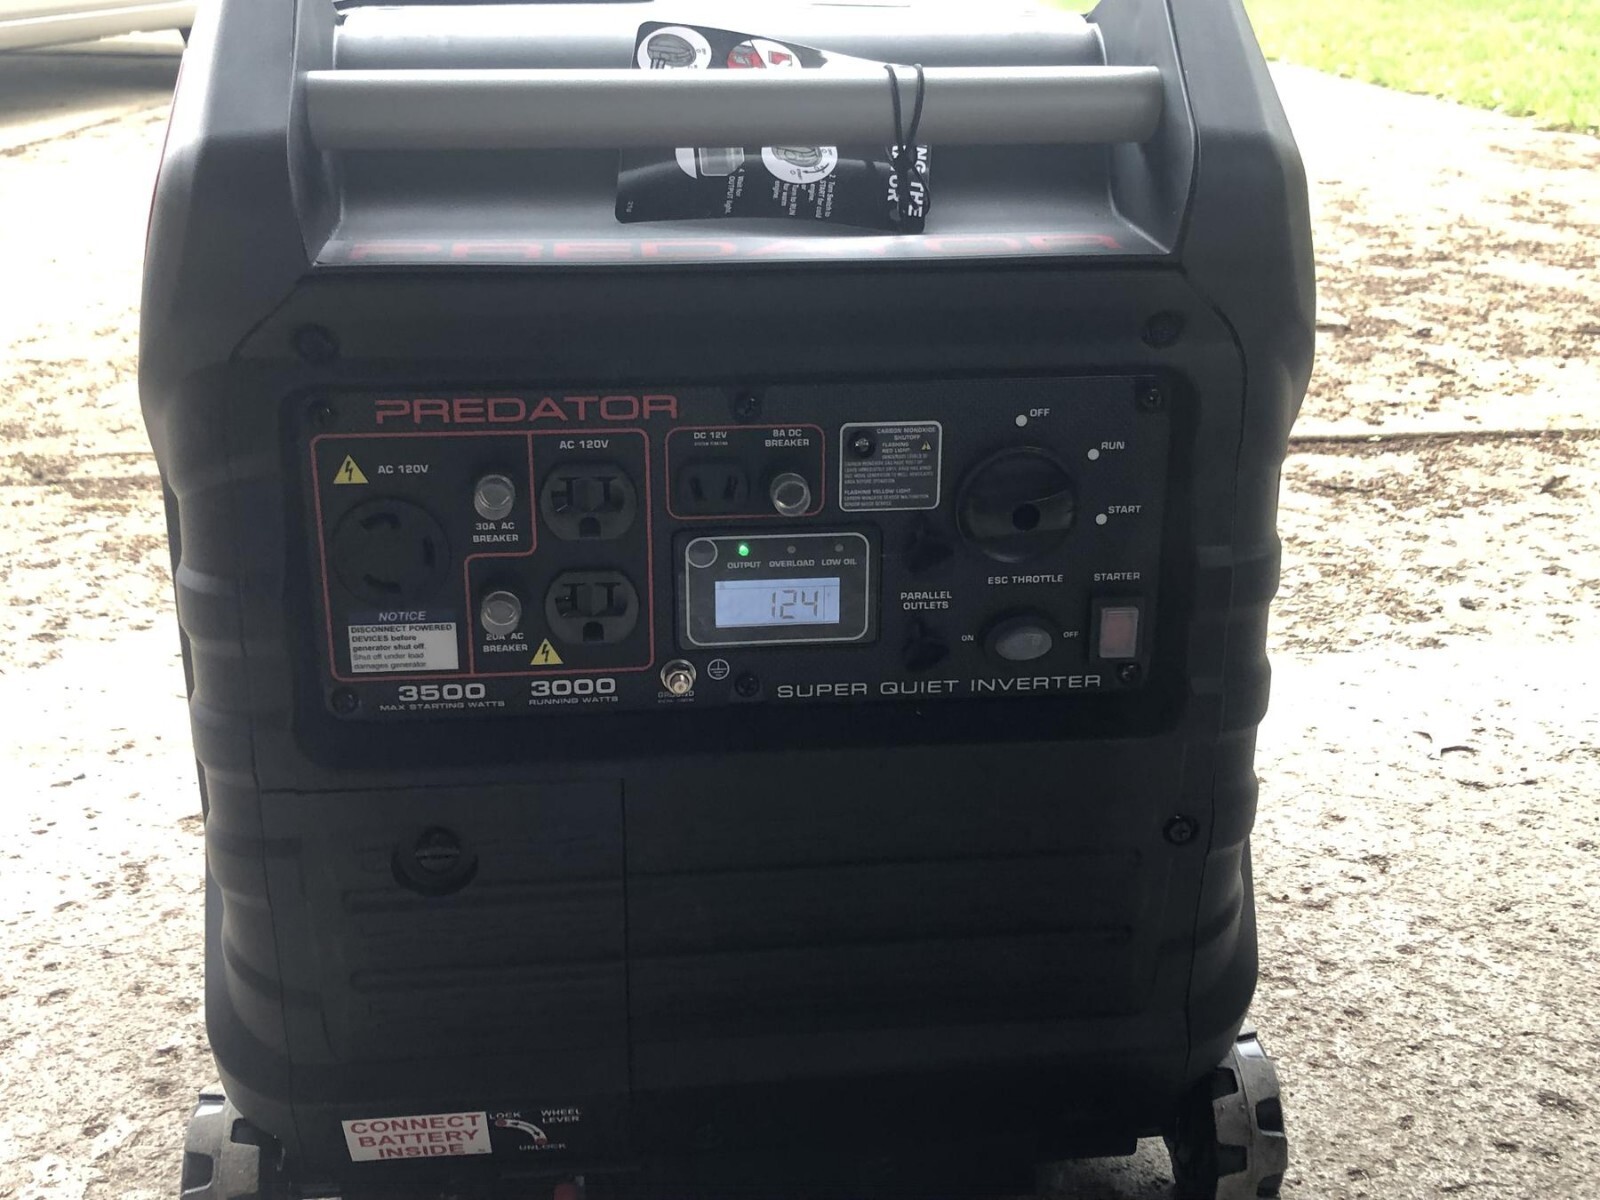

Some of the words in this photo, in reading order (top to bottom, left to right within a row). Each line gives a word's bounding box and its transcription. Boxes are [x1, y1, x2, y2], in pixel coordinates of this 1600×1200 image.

[375, 395, 678, 424] PREDATOR
[1029, 408, 1050, 417] OFF
[693, 431, 706, 439] DC
[709, 431, 728, 439] 12V
[788, 428, 803, 437] DC
[559, 440, 575, 449] AC
[579, 439, 609, 449] 120V
[764, 438, 810, 447] BREAKER
[1100, 441, 1125, 450] RUN
[377, 465, 394, 474] AC
[397, 464, 429, 474] 120V
[1107, 505, 1141, 514] START
[475, 522, 496, 531] 30A
[501, 521, 515, 530] AC
[472, 533, 519, 544] BREAKER
[727, 561, 761, 570] OUTPUT
[768, 559, 815, 568] OVERLOAD
[821, 558, 841, 567] LOW
[843, 558, 858, 566] OIL
[987, 576, 1009, 585] ESC
[1011, 574, 1064, 584] THROTTLE
[1093, 572, 1141, 582] STARTER
[900, 590, 952, 600] PARALLEL
[772, 590, 818, 620] 124
[903, 601, 949, 610] OUTLETS
[378, 611, 427, 622] NOTICE
[351, 625, 406, 634] DISCONNECT
[409, 624, 453, 632] POWERED
[351, 635, 389, 643] DEVICES
[391, 634, 417, 642] before
[509, 632, 525, 641] AC
[961, 634, 974, 642] ON
[1063, 630, 1079, 639] OFF
[352, 645, 391, 653] generator
[393, 643, 411, 651] shut
[482, 643, 528, 653] BREAKER
[530, 677, 617, 697] 3000
[777, 682, 868, 698] SUPER
[879, 680, 959, 696] QUIET
[970, 674, 1102, 692] INVERTER
[397, 683, 487, 702] 3500
[528, 696, 579, 706] RUNNING
[581, 695, 619, 704] WATTS
[378, 703, 406, 712] MAX
[408, 702, 466, 711] STARTING
[467, 700, 506, 710] WATTS
[489, 1111, 521, 1120] LOCK
[540, 1108, 582, 1117] WHEEL
[350, 1115, 482, 1134] CONNECT
[542, 1116, 580, 1124] LEVER
[359, 1129, 479, 1148] BATTERY
[378, 1143, 466, 1158] INSIDE
[518, 1143, 567, 1152] UNLOCK
